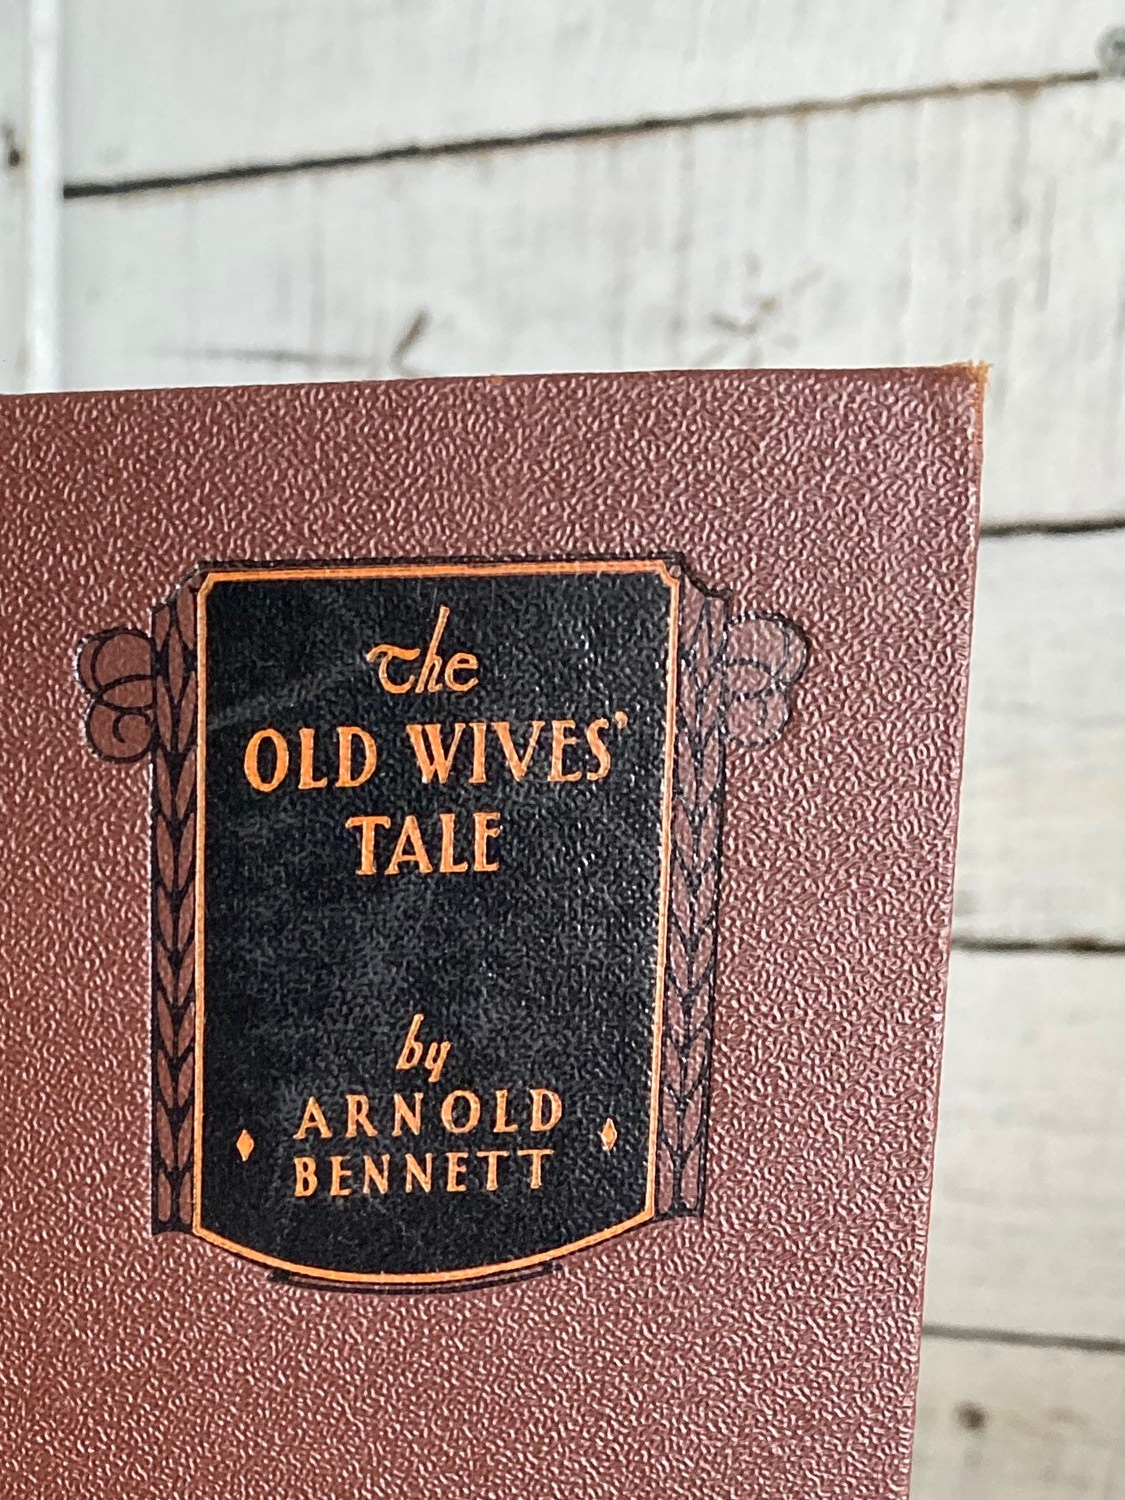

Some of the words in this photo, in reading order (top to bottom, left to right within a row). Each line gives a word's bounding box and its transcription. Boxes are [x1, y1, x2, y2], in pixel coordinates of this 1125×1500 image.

[367, 604, 479, 694] The
[243, 726, 378, 793] OLD
[405, 710, 628, 785] WIVES'
[346, 811, 501, 876] TALE
[395, 1013, 452, 1083] by
[294, 1088, 563, 1140] ARNOLD
[294, 1148, 553, 1197] BENNETT
